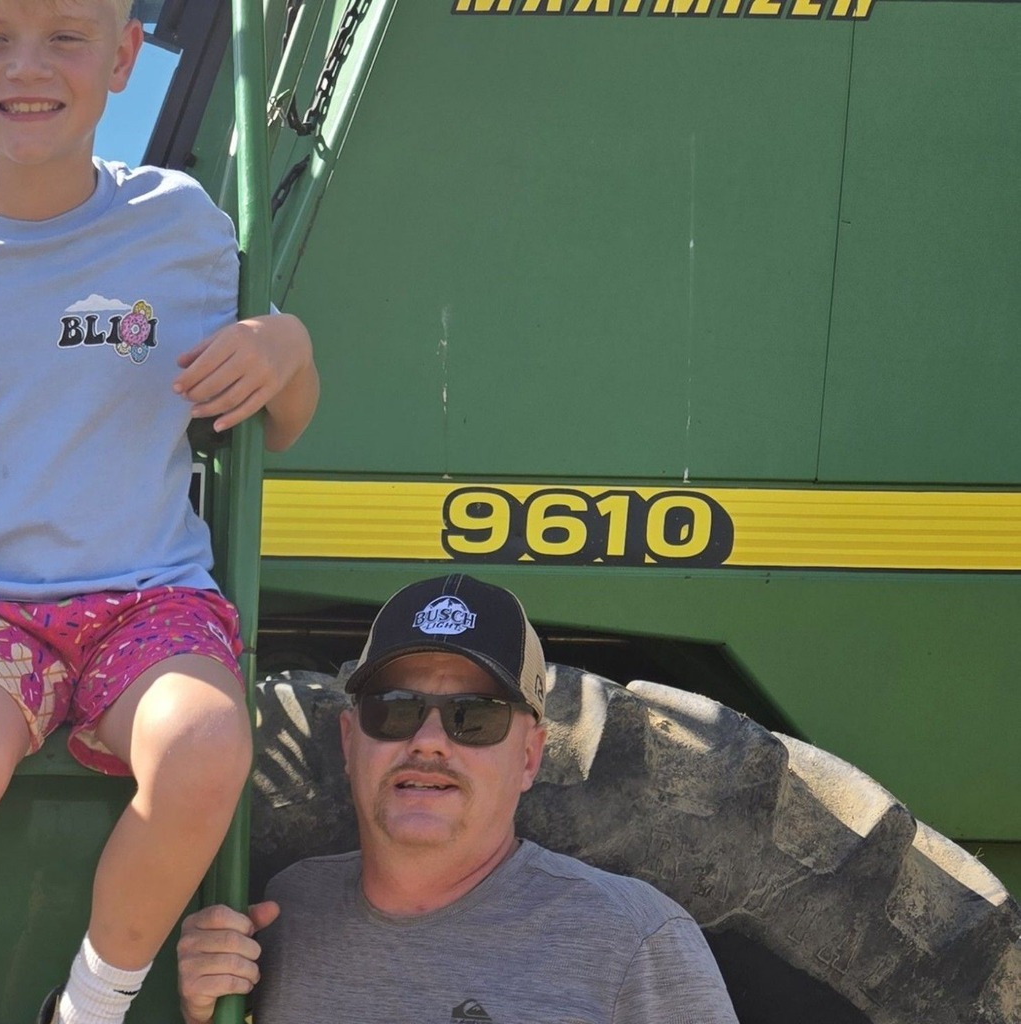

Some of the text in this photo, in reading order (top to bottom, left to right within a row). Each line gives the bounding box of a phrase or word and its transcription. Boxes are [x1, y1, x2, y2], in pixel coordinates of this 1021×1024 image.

[443, 488, 724, 563] 9610
[414, 608, 475, 627] BUSCH
[425, 621, 461, 631] LIGHT
